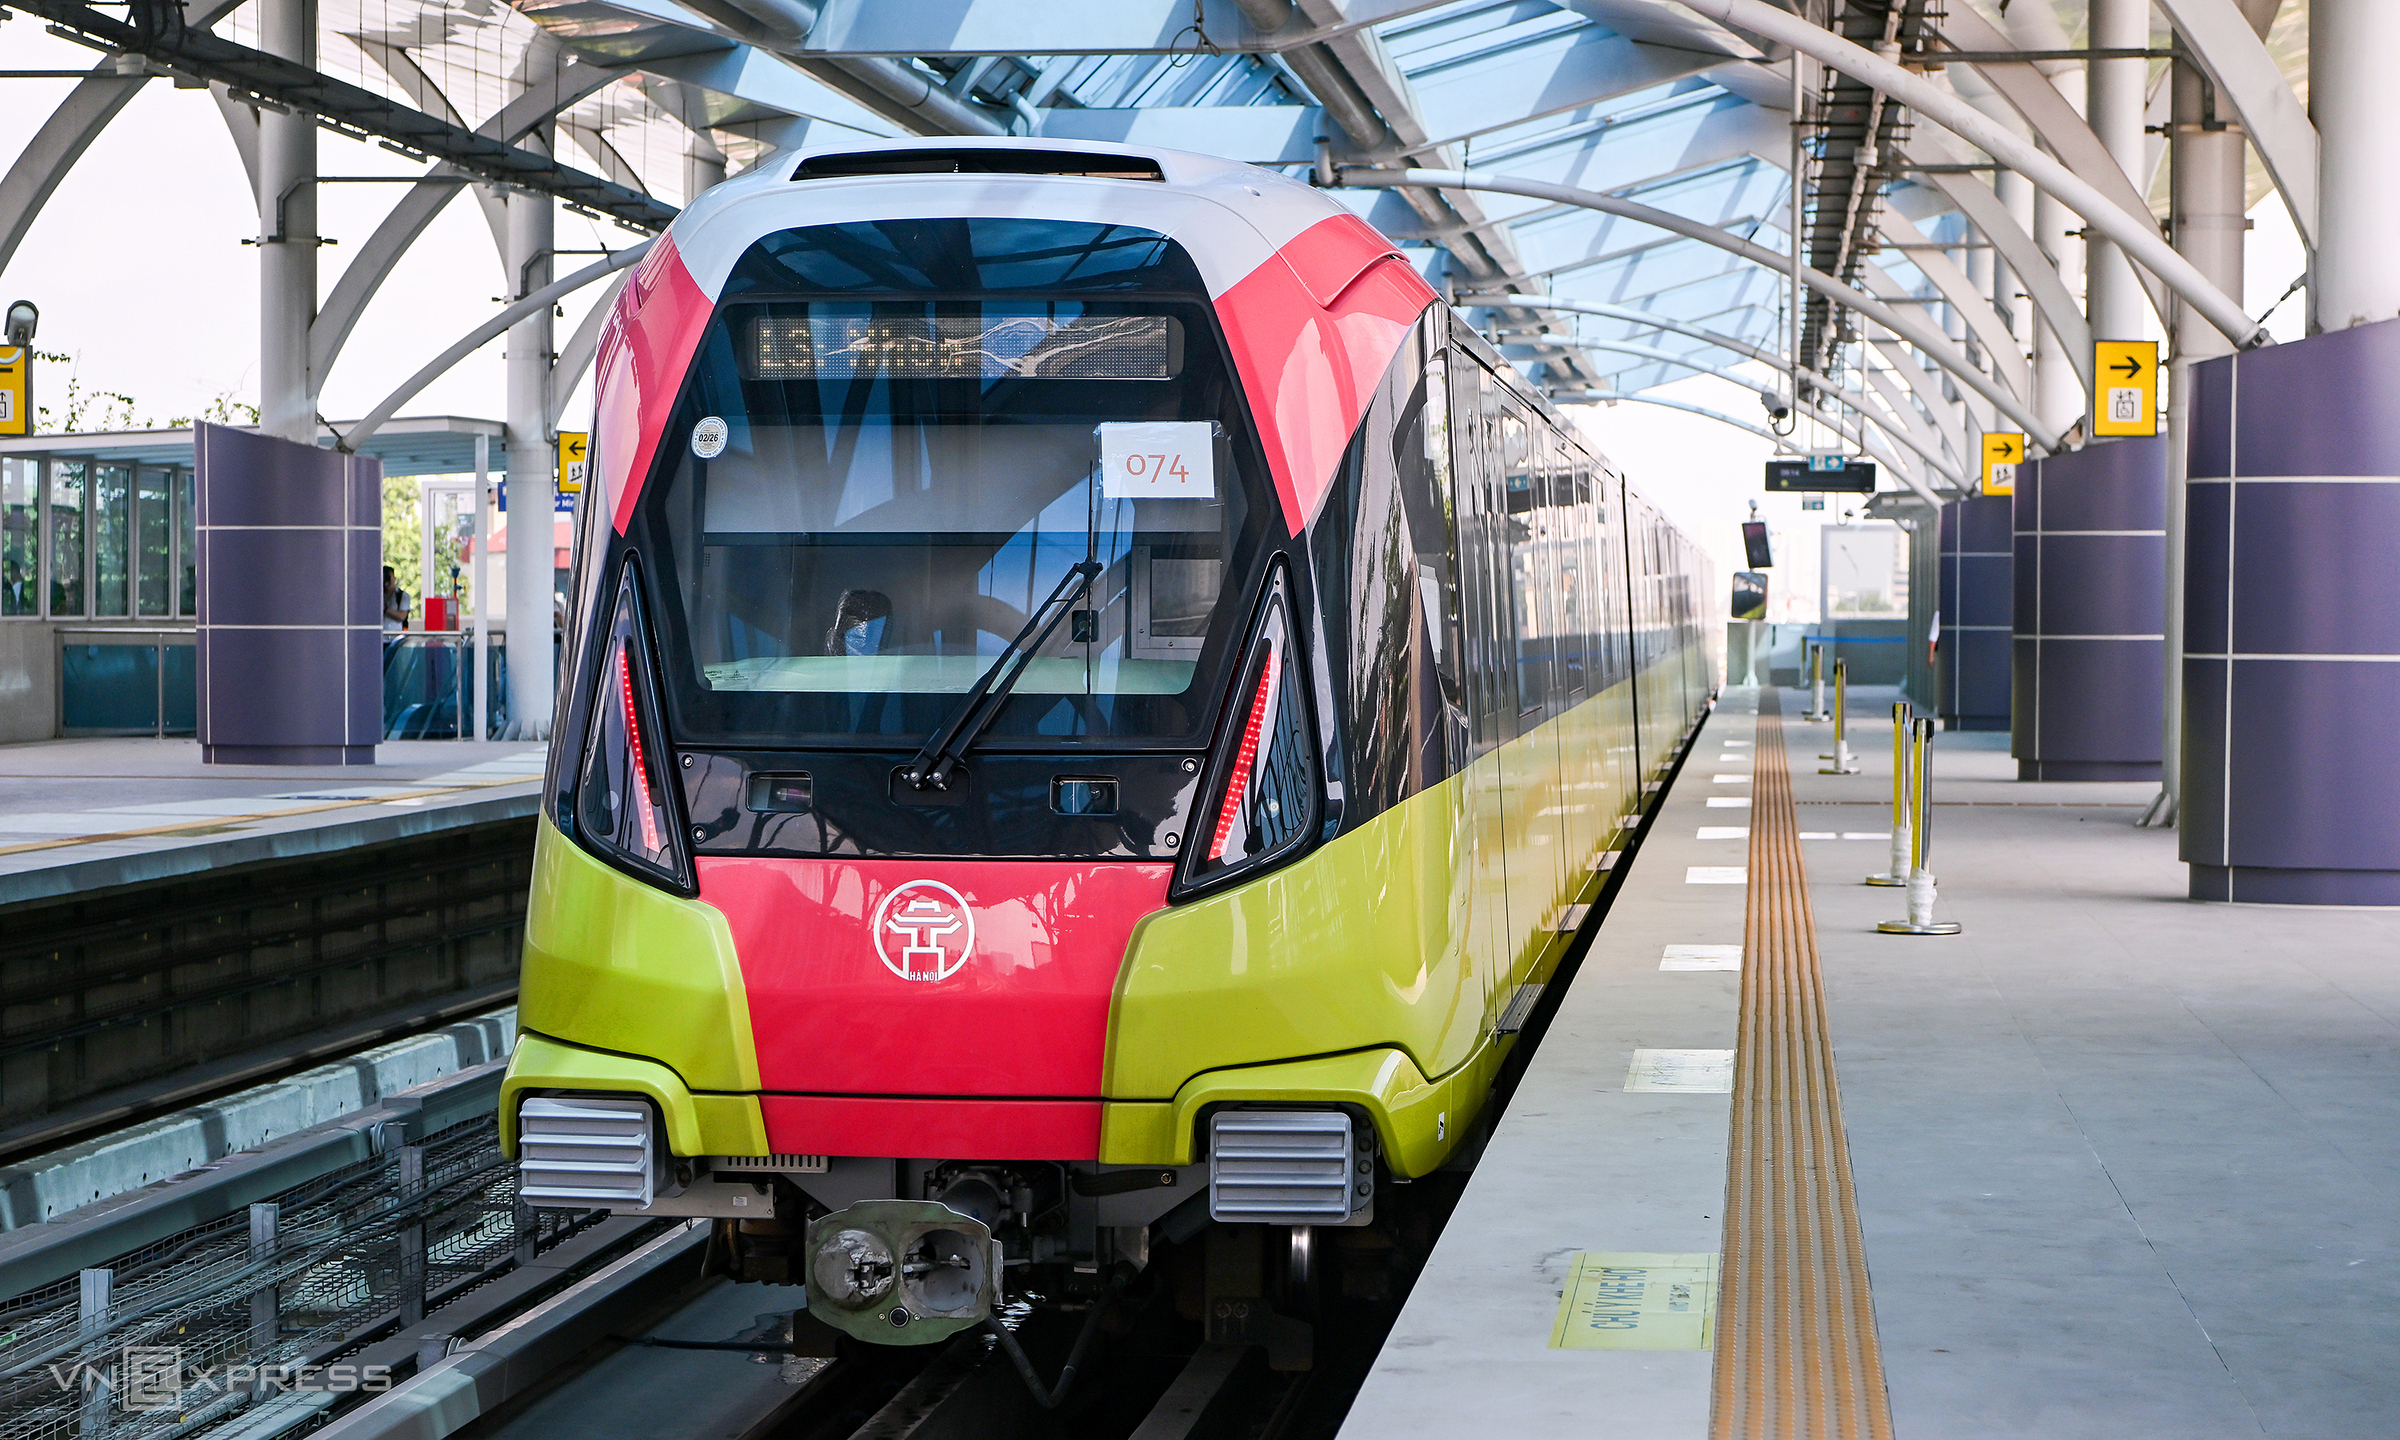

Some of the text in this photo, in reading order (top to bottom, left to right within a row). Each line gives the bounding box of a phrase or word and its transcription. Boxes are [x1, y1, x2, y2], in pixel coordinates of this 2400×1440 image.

[698, 433, 719, 442] 02/26
[1126, 454, 1190, 484] 074
[1588, 1267, 1648, 1281] HỞ
[1597, 1282, 1646, 1300] KHE
[1582, 1309, 1641, 1330] CHÚ
